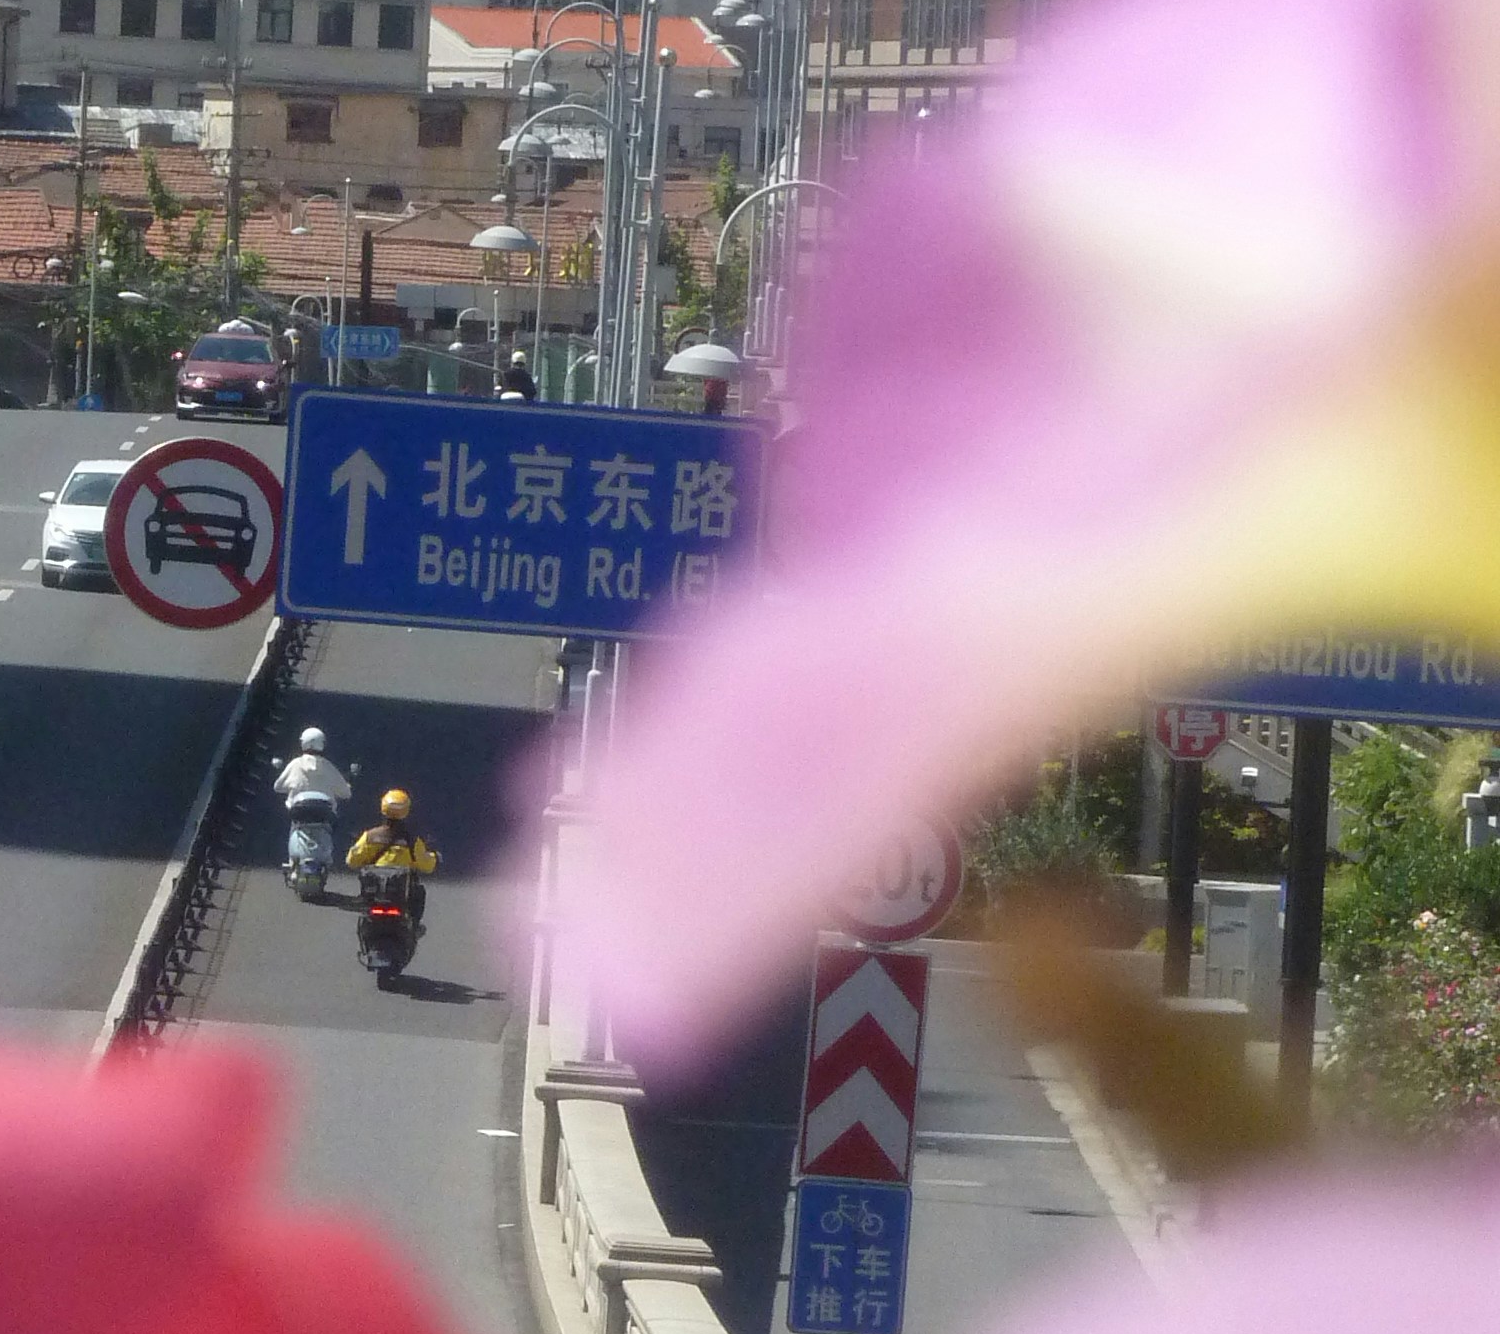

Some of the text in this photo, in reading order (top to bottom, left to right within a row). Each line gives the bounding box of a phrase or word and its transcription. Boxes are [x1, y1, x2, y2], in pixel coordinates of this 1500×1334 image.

[422, 442, 738, 538] 北京东路
[417, 534, 719, 609] Beijing Rd. (E)
[1419, 633, 1485, 685] Rd.
[1165, 706, 1220, 751] 停
[810, 1243, 891, 1280] 下车
[806, 1285, 889, 1327] 推行
